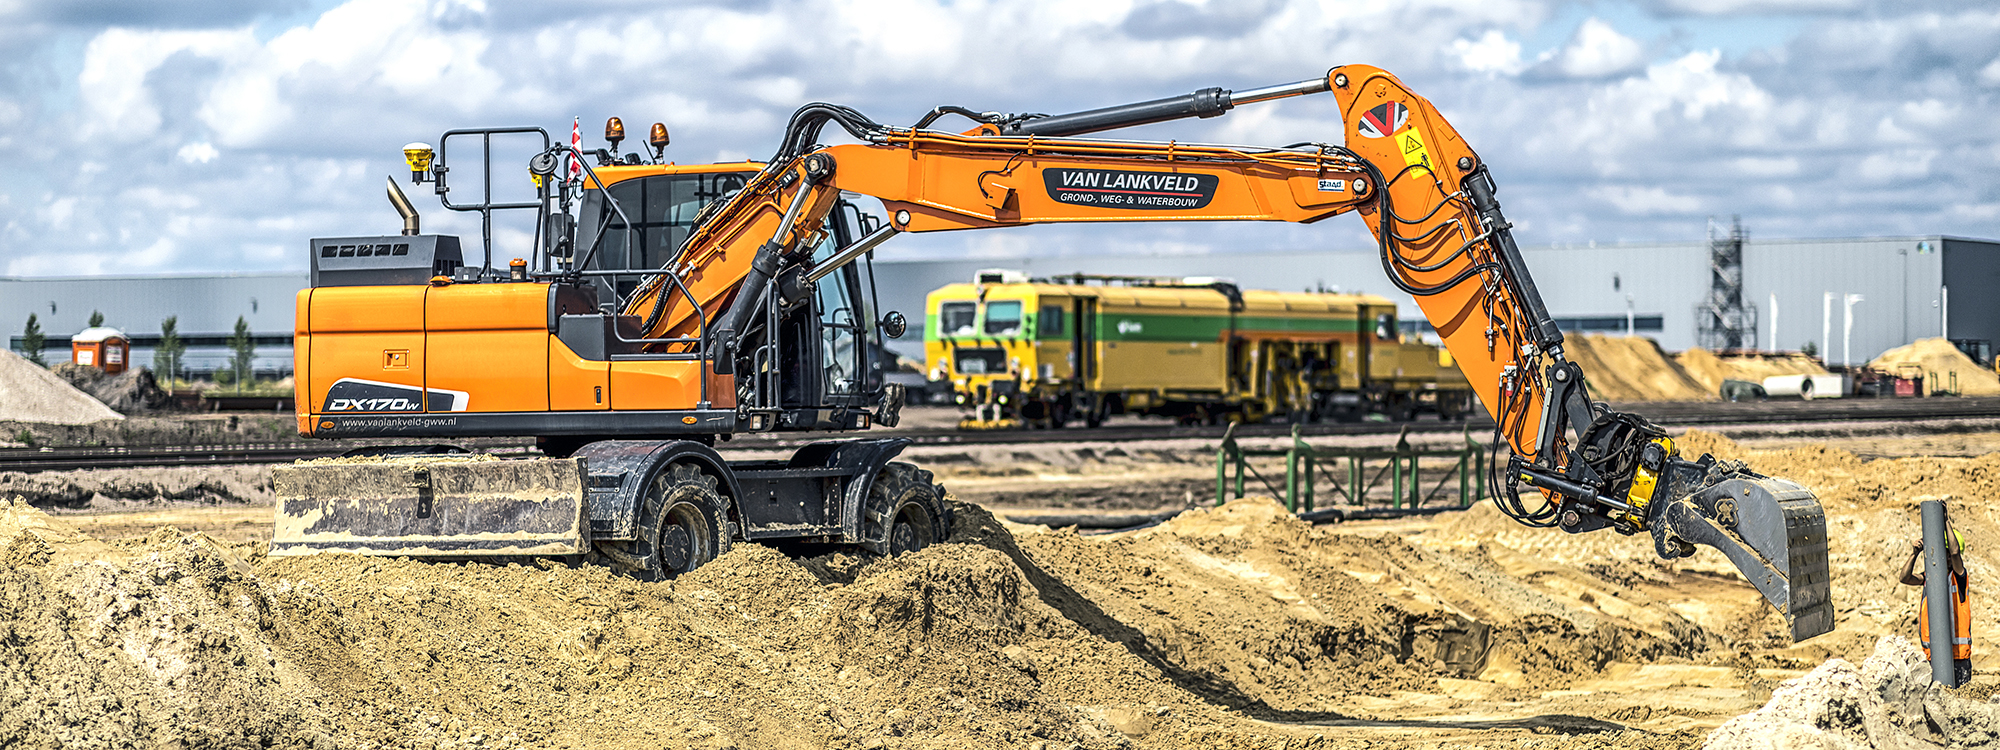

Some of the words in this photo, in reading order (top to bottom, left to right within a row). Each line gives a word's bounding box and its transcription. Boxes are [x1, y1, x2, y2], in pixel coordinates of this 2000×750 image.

[1062, 171, 1100, 187] VAN
[1103, 173, 1199, 192] LANKVELD
[1060, 192, 1098, 204] GROND-,
[1101, 194, 1125, 204] WEG-
[1126, 195, 1134, 204] &
[1137, 196, 1198, 207] WATERBOUW
[342, 417, 457, 428] www.vanlankveld-gww.nl
